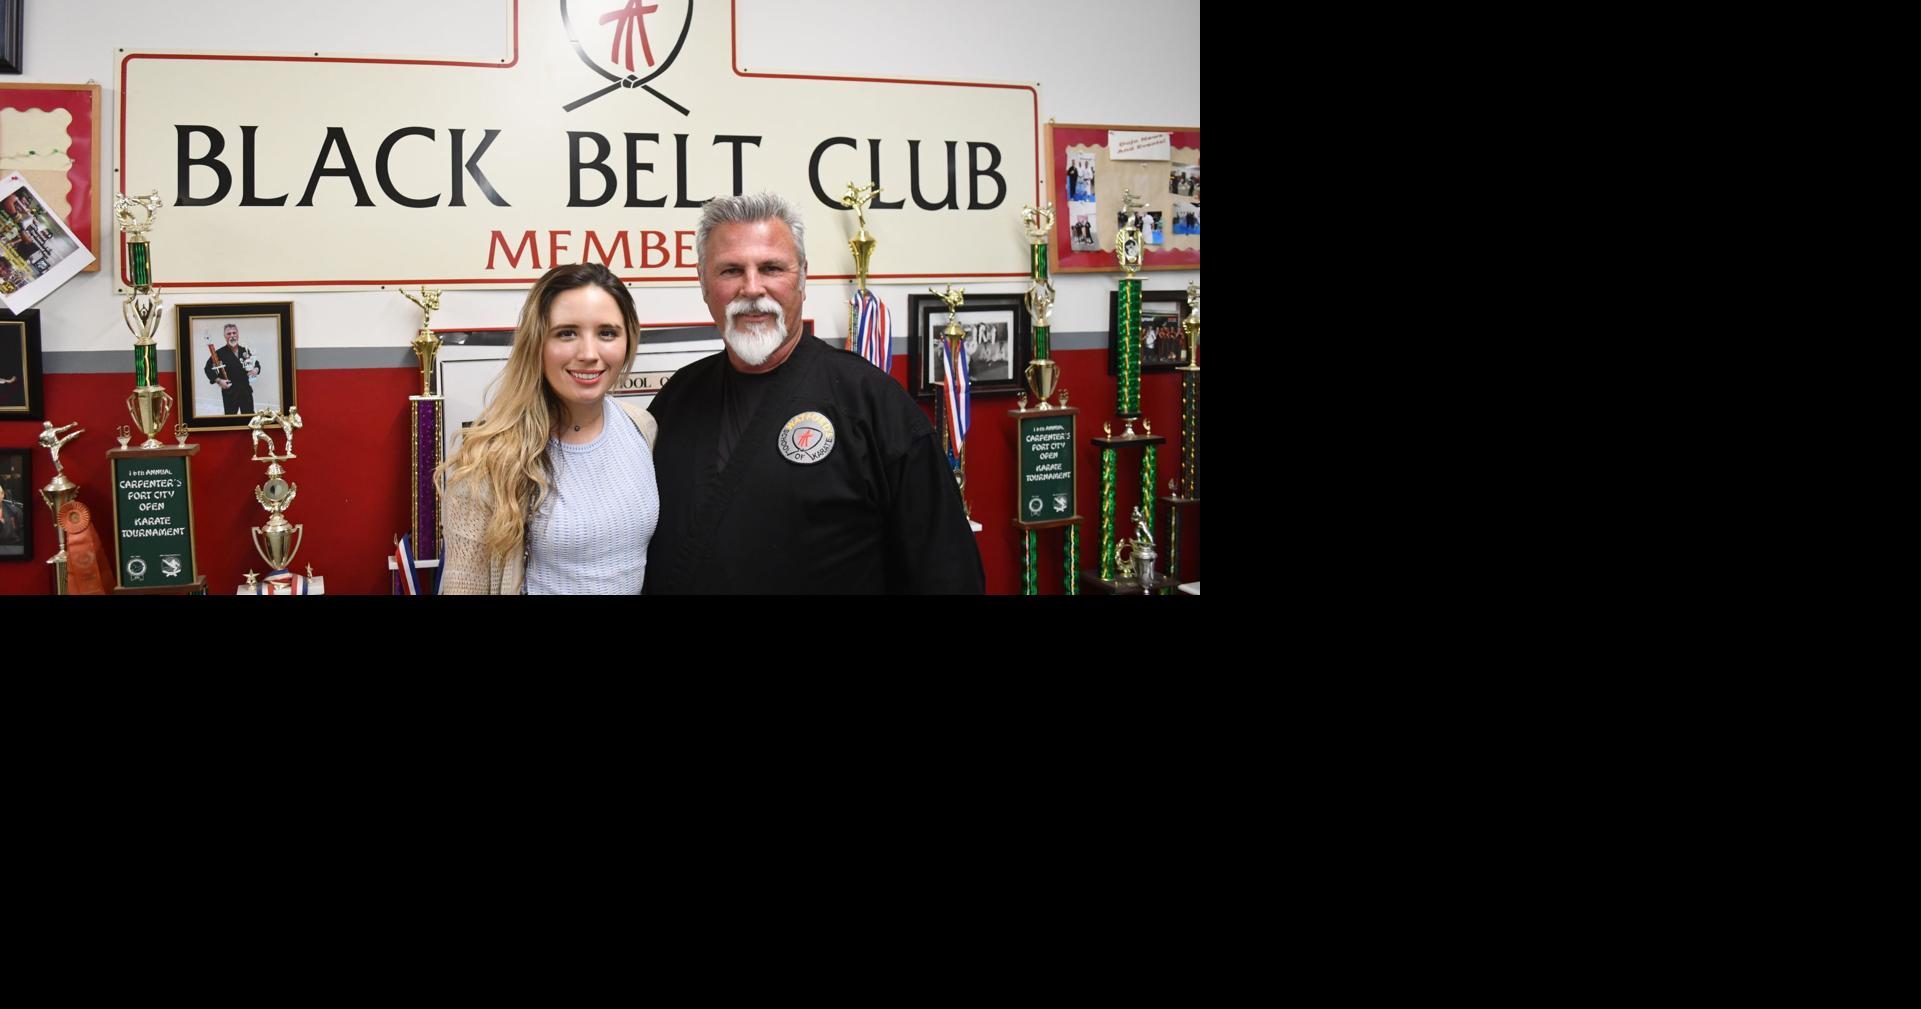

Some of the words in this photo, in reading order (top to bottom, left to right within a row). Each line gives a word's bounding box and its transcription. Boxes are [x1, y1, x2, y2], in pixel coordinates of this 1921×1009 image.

[173, 124, 512, 209] BLACK
[566, 131, 763, 208] BELT
[808, 136, 1007, 211] CLUB
[486, 230, 698, 270] MEMBE
[621, 377, 652, 388] OOL
[1026, 432, 1071, 442] CARPENTER'S
[812, 438, 833, 460] KARATE
[1050, 442, 1066, 450] CITY
[1040, 452, 1058, 460] OPEN
[1036, 463, 1062, 472] KARATE
[1026, 471, 1071, 482] TOURNAMENT
[120, 479, 182, 489] CARPENTER'S
[153, 490, 175, 499] CITY
[139, 502, 165, 511] OPEN
[134, 516, 171, 526] KARATE
[121, 527, 185, 538] TOURNAMENT
